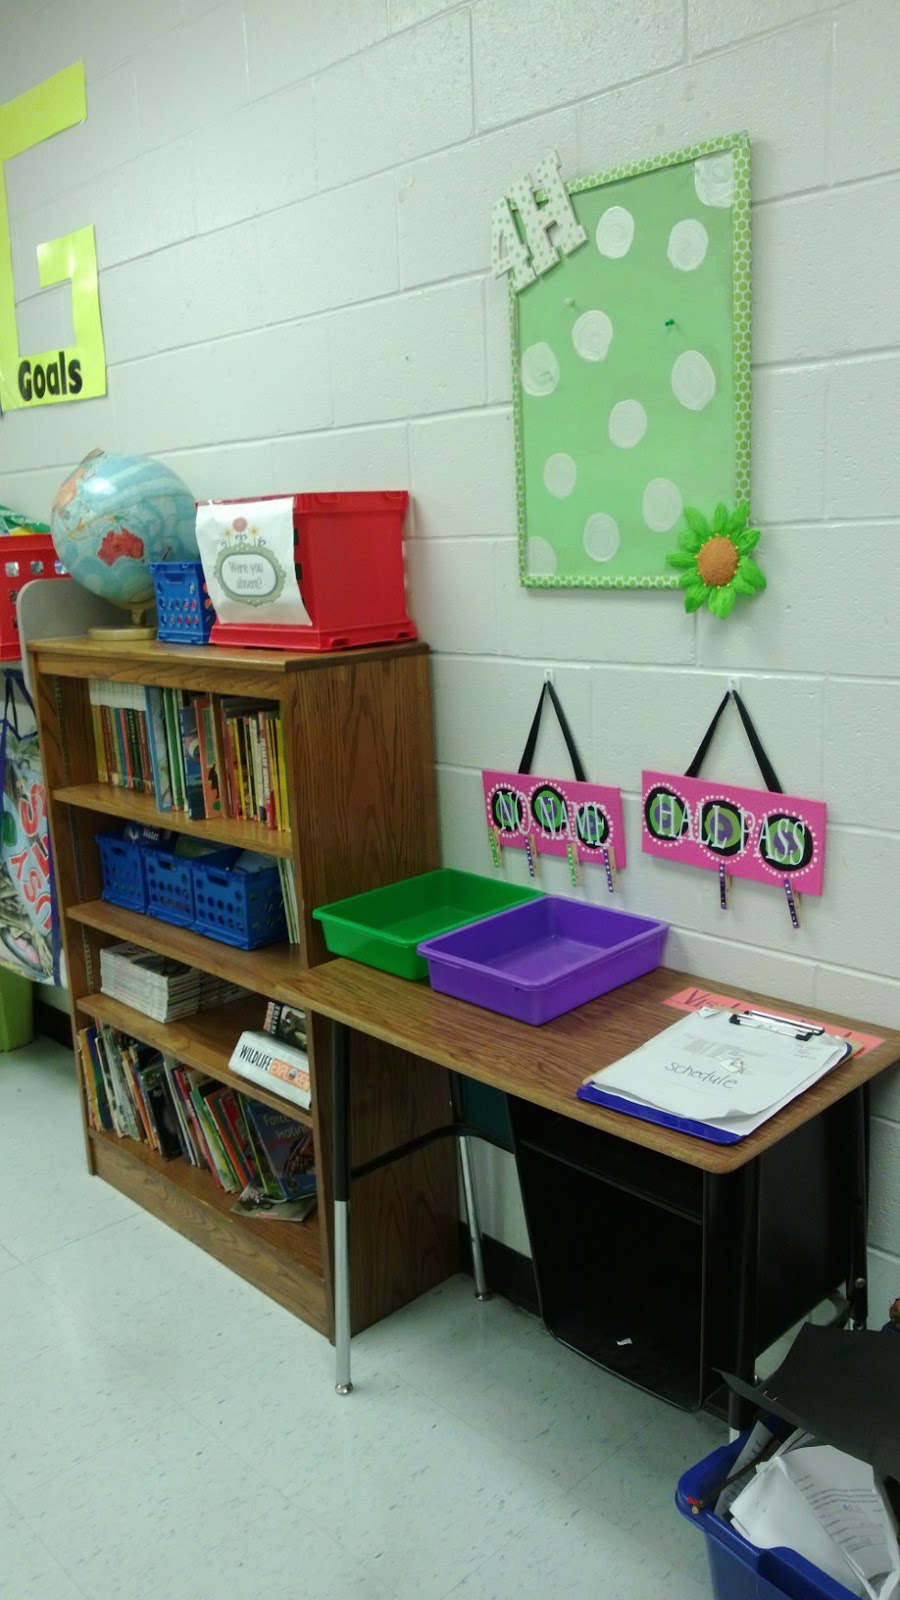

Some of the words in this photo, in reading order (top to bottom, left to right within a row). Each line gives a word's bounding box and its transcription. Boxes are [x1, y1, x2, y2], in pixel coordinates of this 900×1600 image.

[18, 351, 83, 402] Goals
[228, 561, 249, 573] Were
[250, 563, 264, 576] you
[497, 791, 532, 835] NO
[537, 797, 611, 847] NAME
[656, 793, 727, 850] HALL
[737, 808, 806, 866] PASS
[239, 1045, 272, 1071] WILDLIFE
